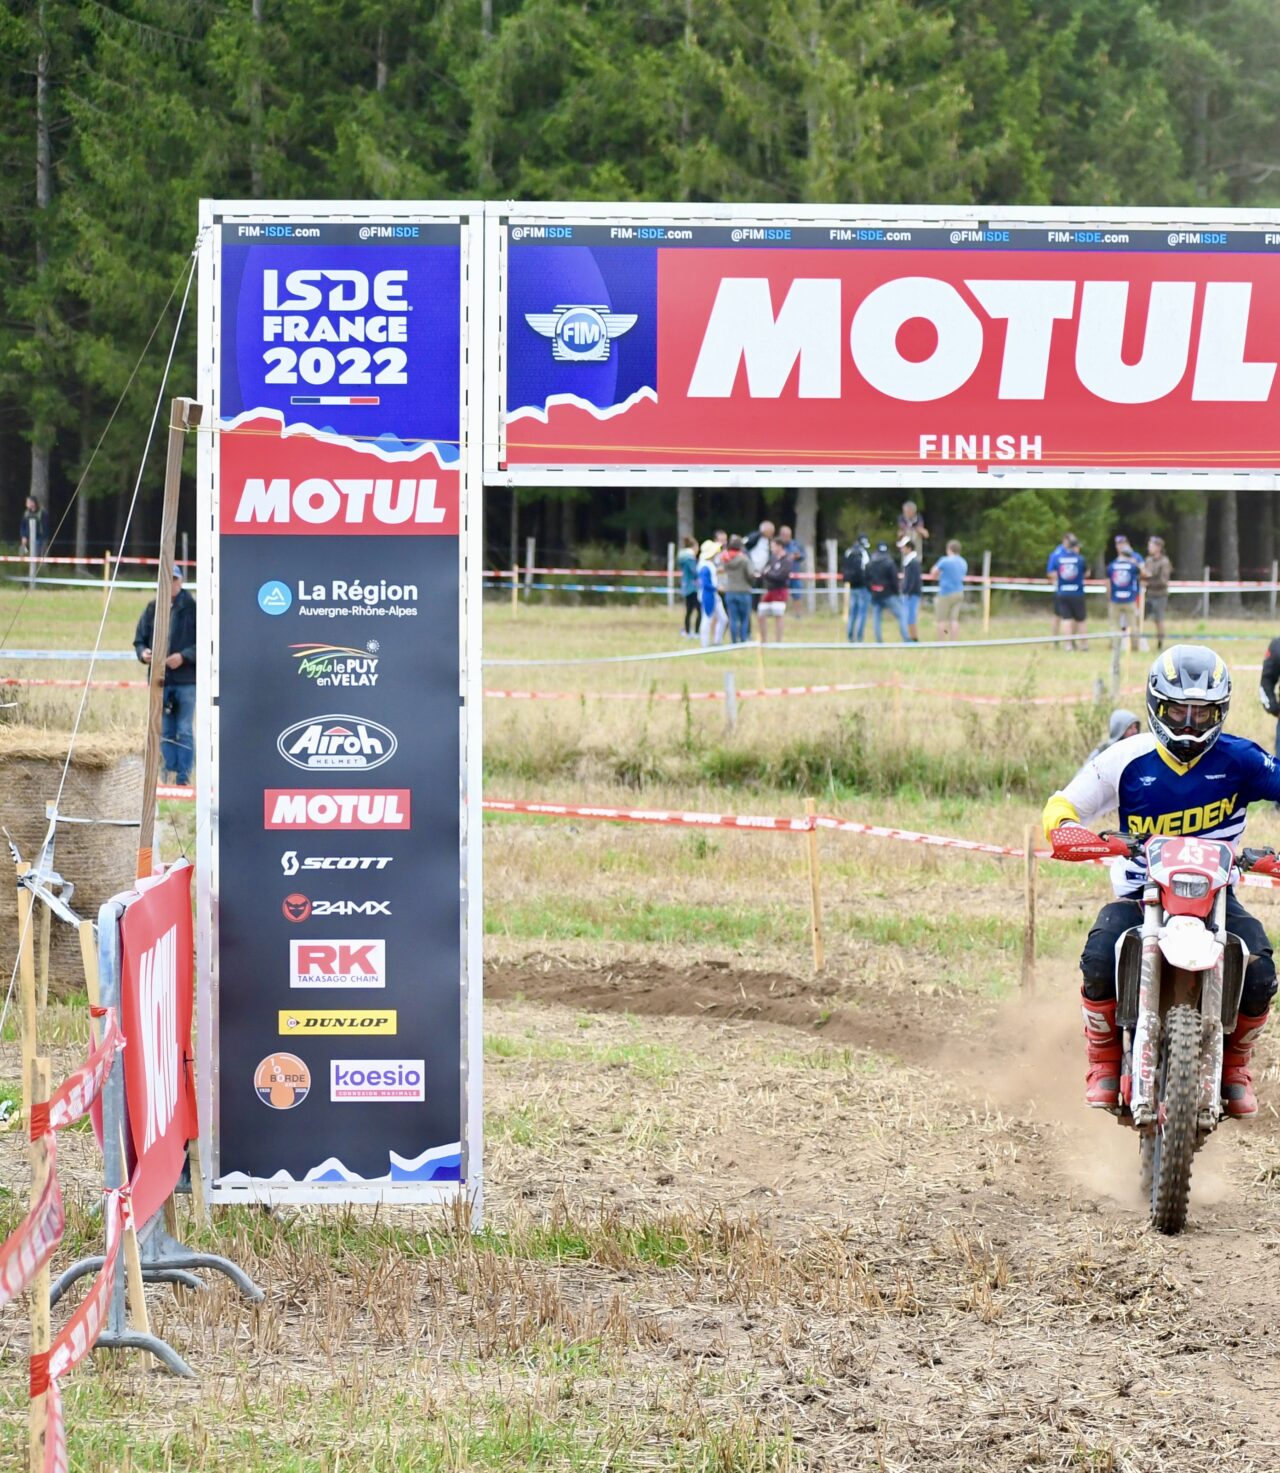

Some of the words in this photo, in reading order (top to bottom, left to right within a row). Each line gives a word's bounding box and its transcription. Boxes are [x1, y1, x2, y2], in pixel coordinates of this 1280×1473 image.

[238, 226, 320, 238] FIM-ISDE.com
[358, 226, 419, 240] @FIMISDE
[511, 227, 572, 241] @FIMISDE
[610, 228, 692, 240] FIM-ISDE.com
[731, 228, 791, 242] @FIMISDE
[829, 229, 911, 242] FIM-ISDE.com
[950, 230, 1010, 244] @FIMISDE
[1048, 231, 1129, 244] FIM-ISDE.com
[1167, 232, 1227, 246] @FIMISDE
[263, 269, 409, 311] ISDE
[263, 315, 407, 342] FRANCE
[563, 321, 600, 345] FIM
[686, 276, 1278, 404] MOTUL
[262, 346, 407, 385] 2022
[919, 433, 1043, 461] FINISH
[234, 477, 446, 524] MOTUL
[298, 580, 326, 600] La
[332, 579, 418, 604] Région
[298, 605, 418, 618] Auvergne-Rhône-Alpes
[331, 674, 379, 686] VELAY
[271, 795, 404, 824] MOTUL
[1127, 793, 1239, 836] SWEDEN
[301, 857, 394, 869] SCOTT
[1177, 845, 1205, 865] 43
[311, 901, 393, 915] 24MX
[297, 945, 377, 975] RK
[298, 975, 347, 983] TAKASAGO
[350, 975, 379, 983] CHAIN
[303, 1017, 389, 1028] DUNLOP
[270, 1074, 306, 1083] BORDE
[335, 1064, 421, 1086] koesio
